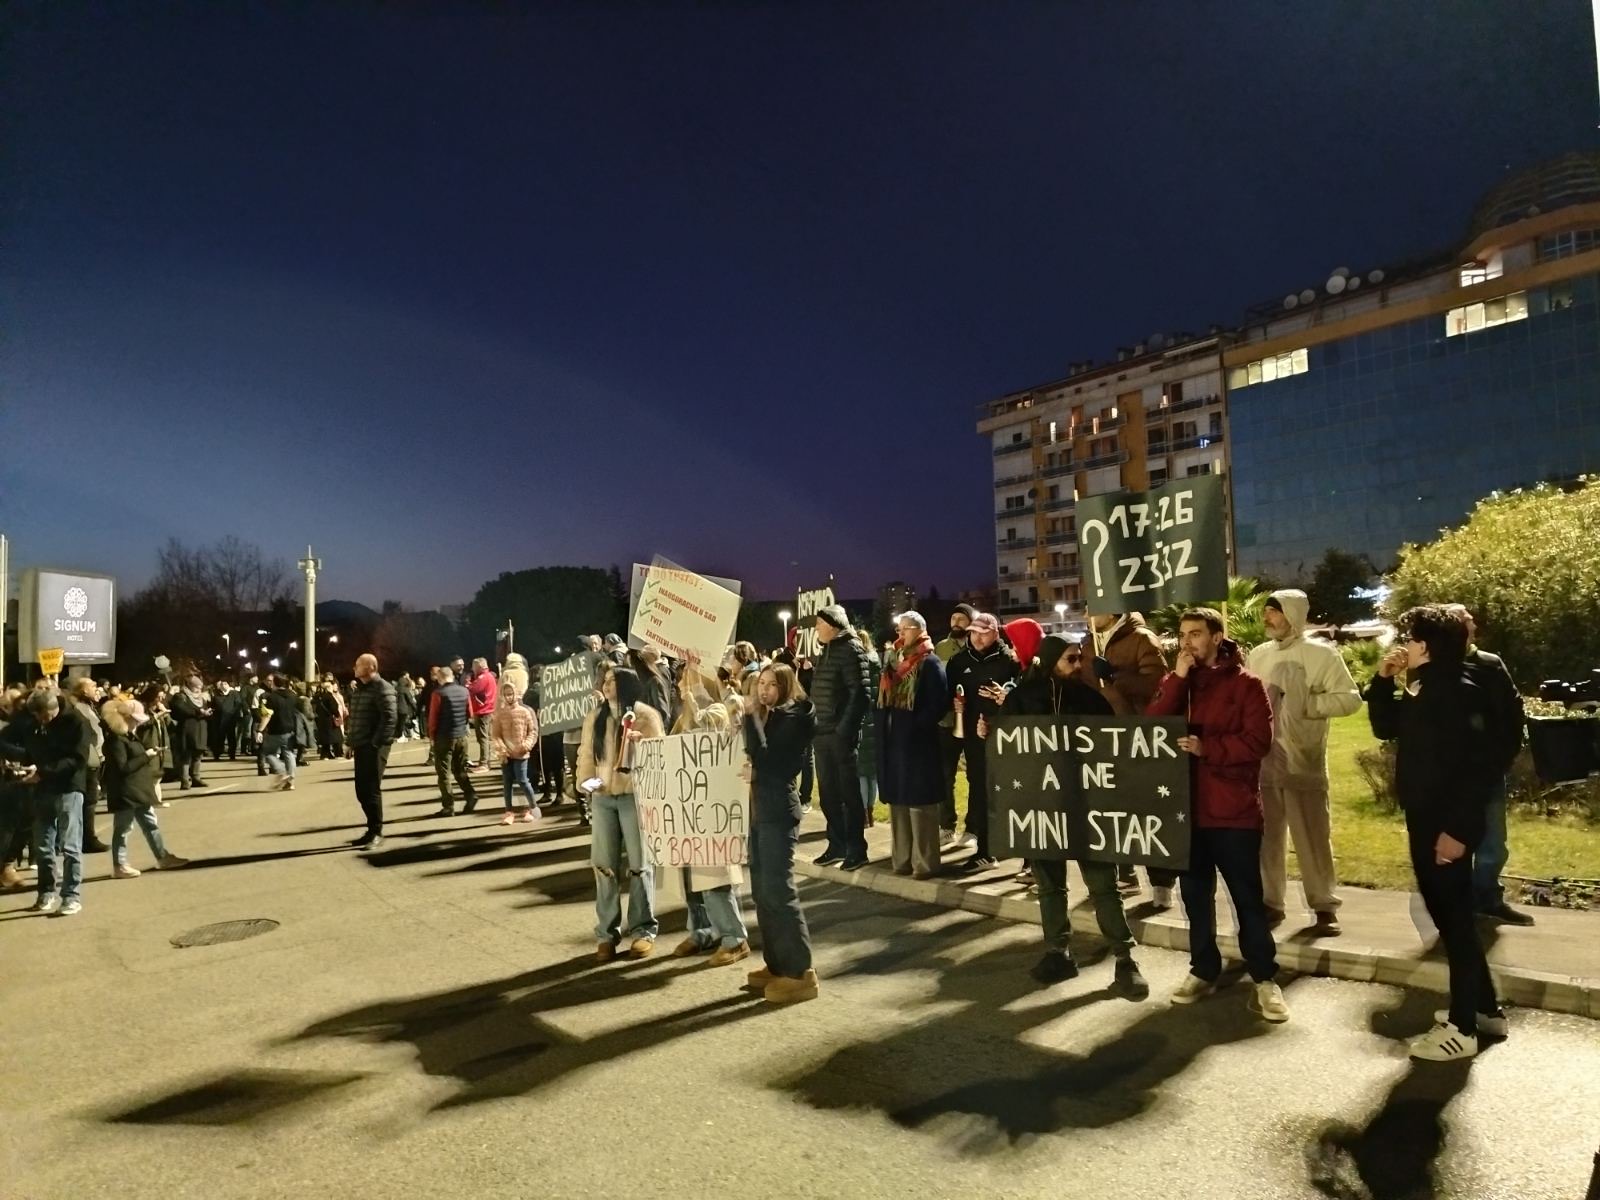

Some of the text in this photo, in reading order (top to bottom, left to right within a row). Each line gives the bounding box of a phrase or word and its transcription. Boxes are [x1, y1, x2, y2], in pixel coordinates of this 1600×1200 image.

[1108, 489, 1194, 539] 17:26
[653, 601, 673, 616] STORY
[698, 607, 704, 616] U
[703, 611, 717, 623] SAD
[54, 618, 96, 632] SIGNUM
[577, 656, 586, 672] JE
[681, 733, 733, 768] NAM
[996, 724, 1178, 758] MINISTAR
[675, 768, 708, 803] DA
[1042, 762, 1116, 791] A NE
[663, 804, 675, 834] A
[681, 802, 707, 834] NE
[711, 802, 743, 834] DA
[1008, 808, 1170, 857] MINI STAR
[647, 835, 664, 866] SE
